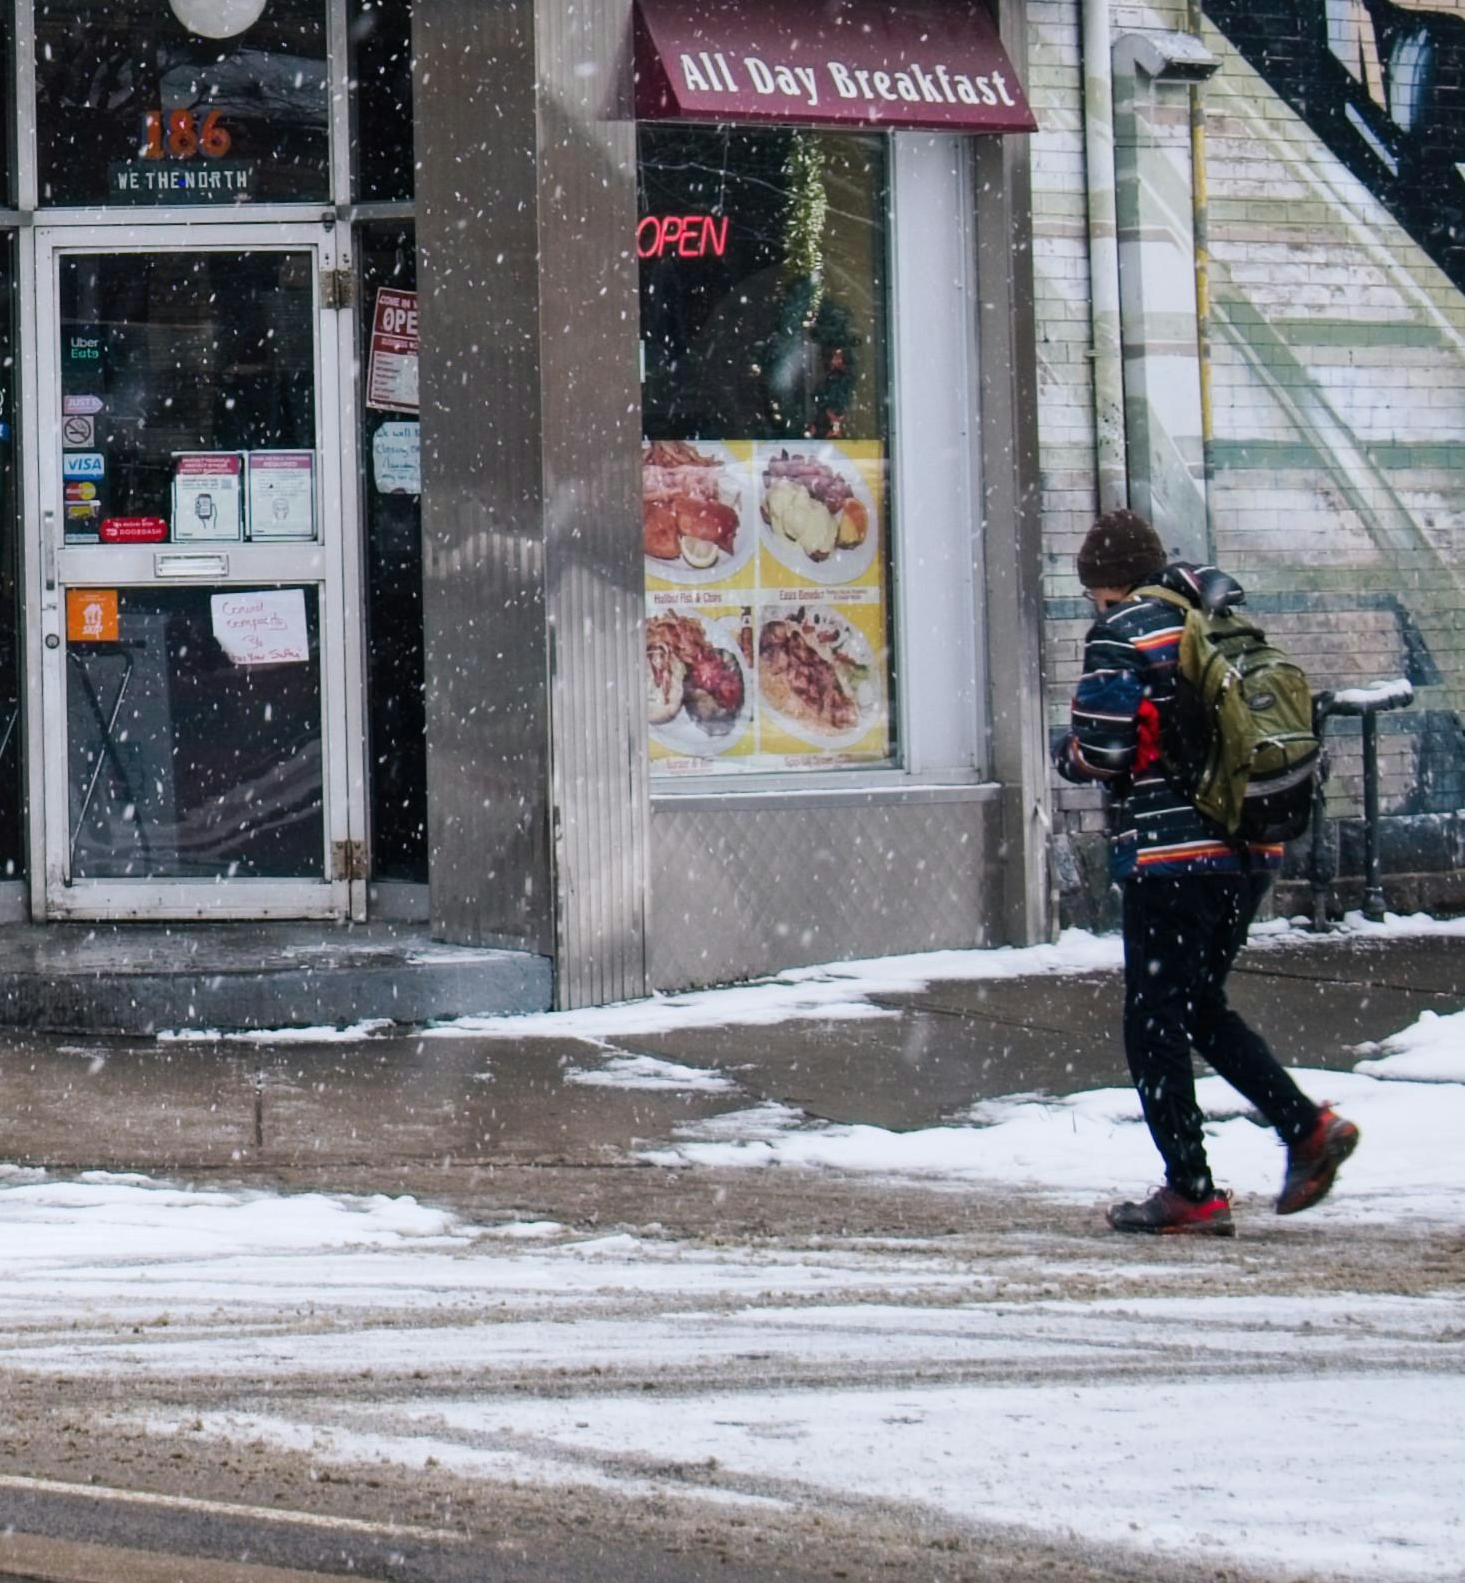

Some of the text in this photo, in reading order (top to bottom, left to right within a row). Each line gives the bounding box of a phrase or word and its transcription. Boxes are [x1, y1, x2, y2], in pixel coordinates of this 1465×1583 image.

[680, 50, 1016, 109] All Day Breakfast
[140, 108, 232, 160] 186
[118, 170, 248, 190] WE THE NORTH
[636, 215, 729, 260] OPEN
[71, 337, 99, 348] Uber
[71, 348, 99, 359] Eats
[68, 458, 102, 470] VISA
